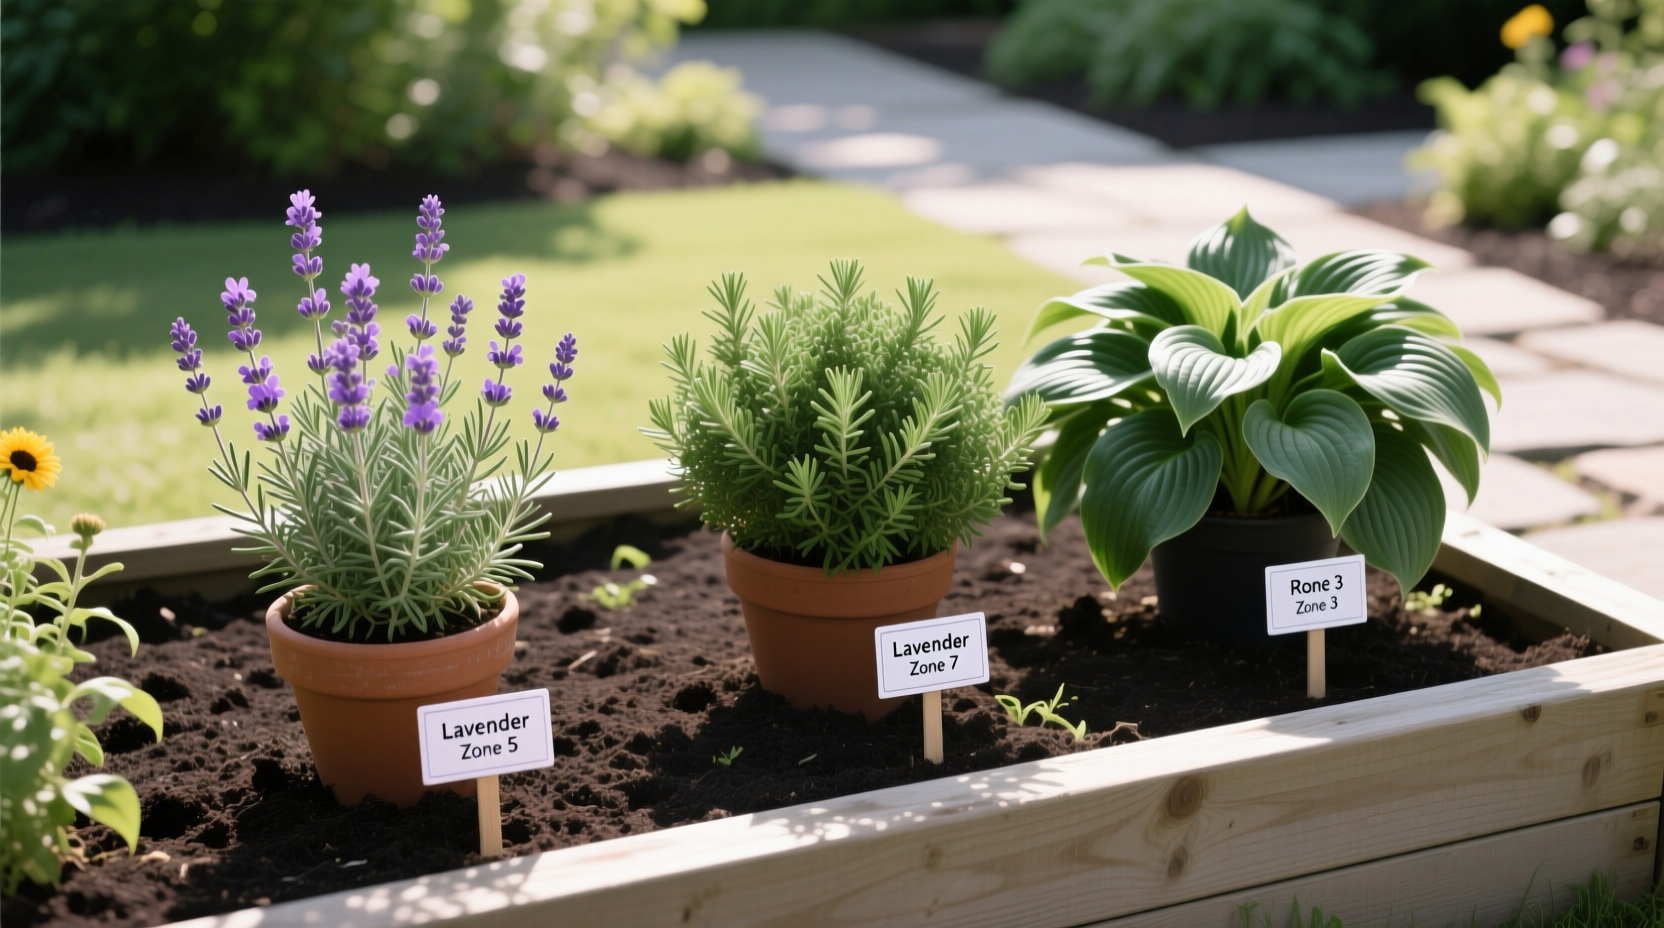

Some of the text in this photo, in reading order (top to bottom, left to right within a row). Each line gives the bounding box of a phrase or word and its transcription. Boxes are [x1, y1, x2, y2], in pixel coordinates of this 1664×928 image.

[1290, 574, 1344, 596] Rone 3
[1295, 595, 1338, 615] Zone 3
[892, 632, 970, 658] Lavender
[909, 654, 959, 677] Zone 7
[442, 712, 530, 740] Lavender
[460, 736, 518, 760] Zone 5
